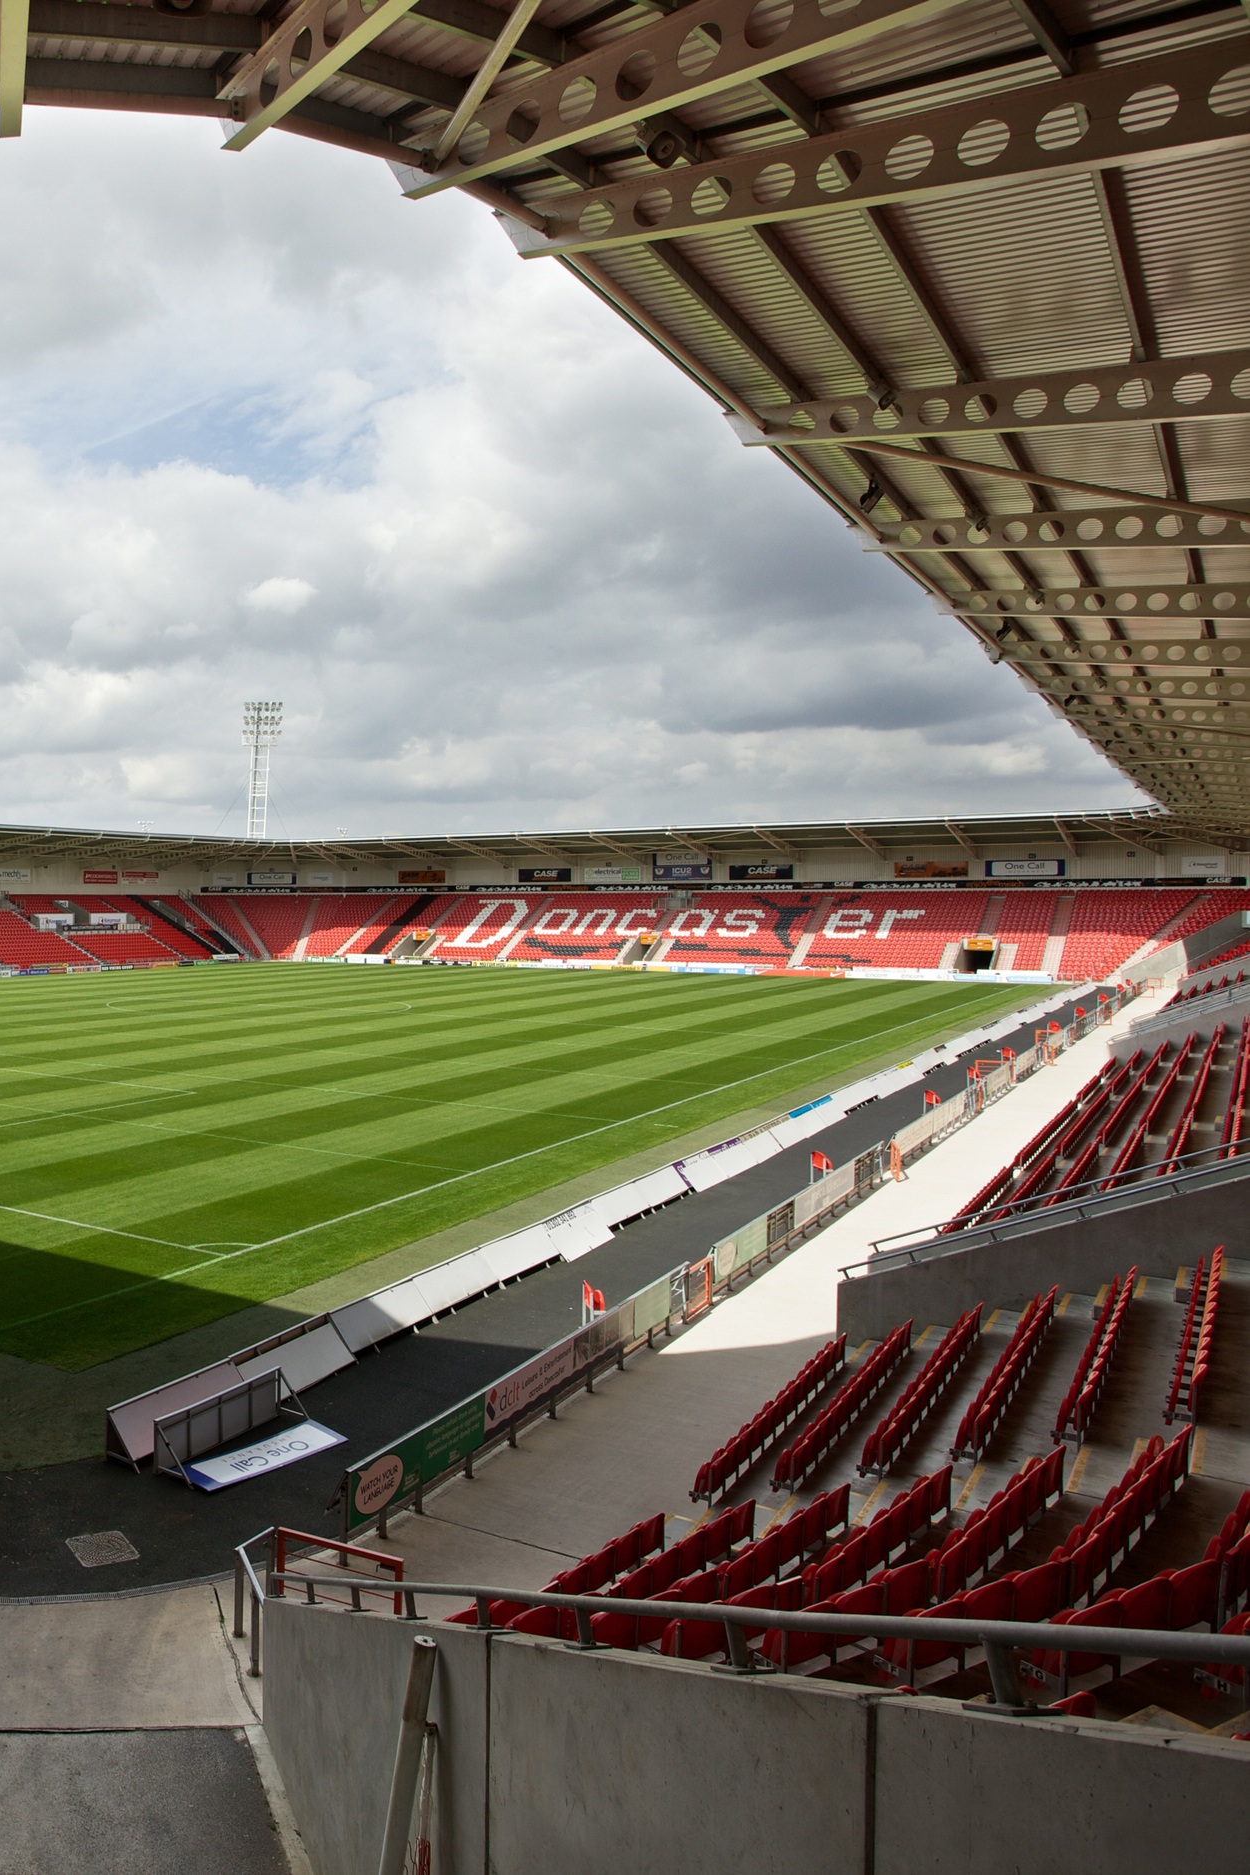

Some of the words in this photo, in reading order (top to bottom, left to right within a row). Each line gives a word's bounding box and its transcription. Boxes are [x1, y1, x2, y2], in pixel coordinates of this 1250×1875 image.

[1004, 862, 1025, 870] One
[521, 1371, 538, 1390] Leisure
[543, 1344, 573, 1372] Entertainment
[528, 1382, 544, 1399] across
[544, 1365, 566, 1387] Doncaster
[221, 1435, 291, 1462] INSURANCE
[267, 1440, 309, 1458] One
[230, 1455, 269, 1473] Call
[360, 1473, 382, 1495] WATCH
[382, 1464, 399, 1482] YOUR
[363, 1477, 395, 1506] LANGUAGE
